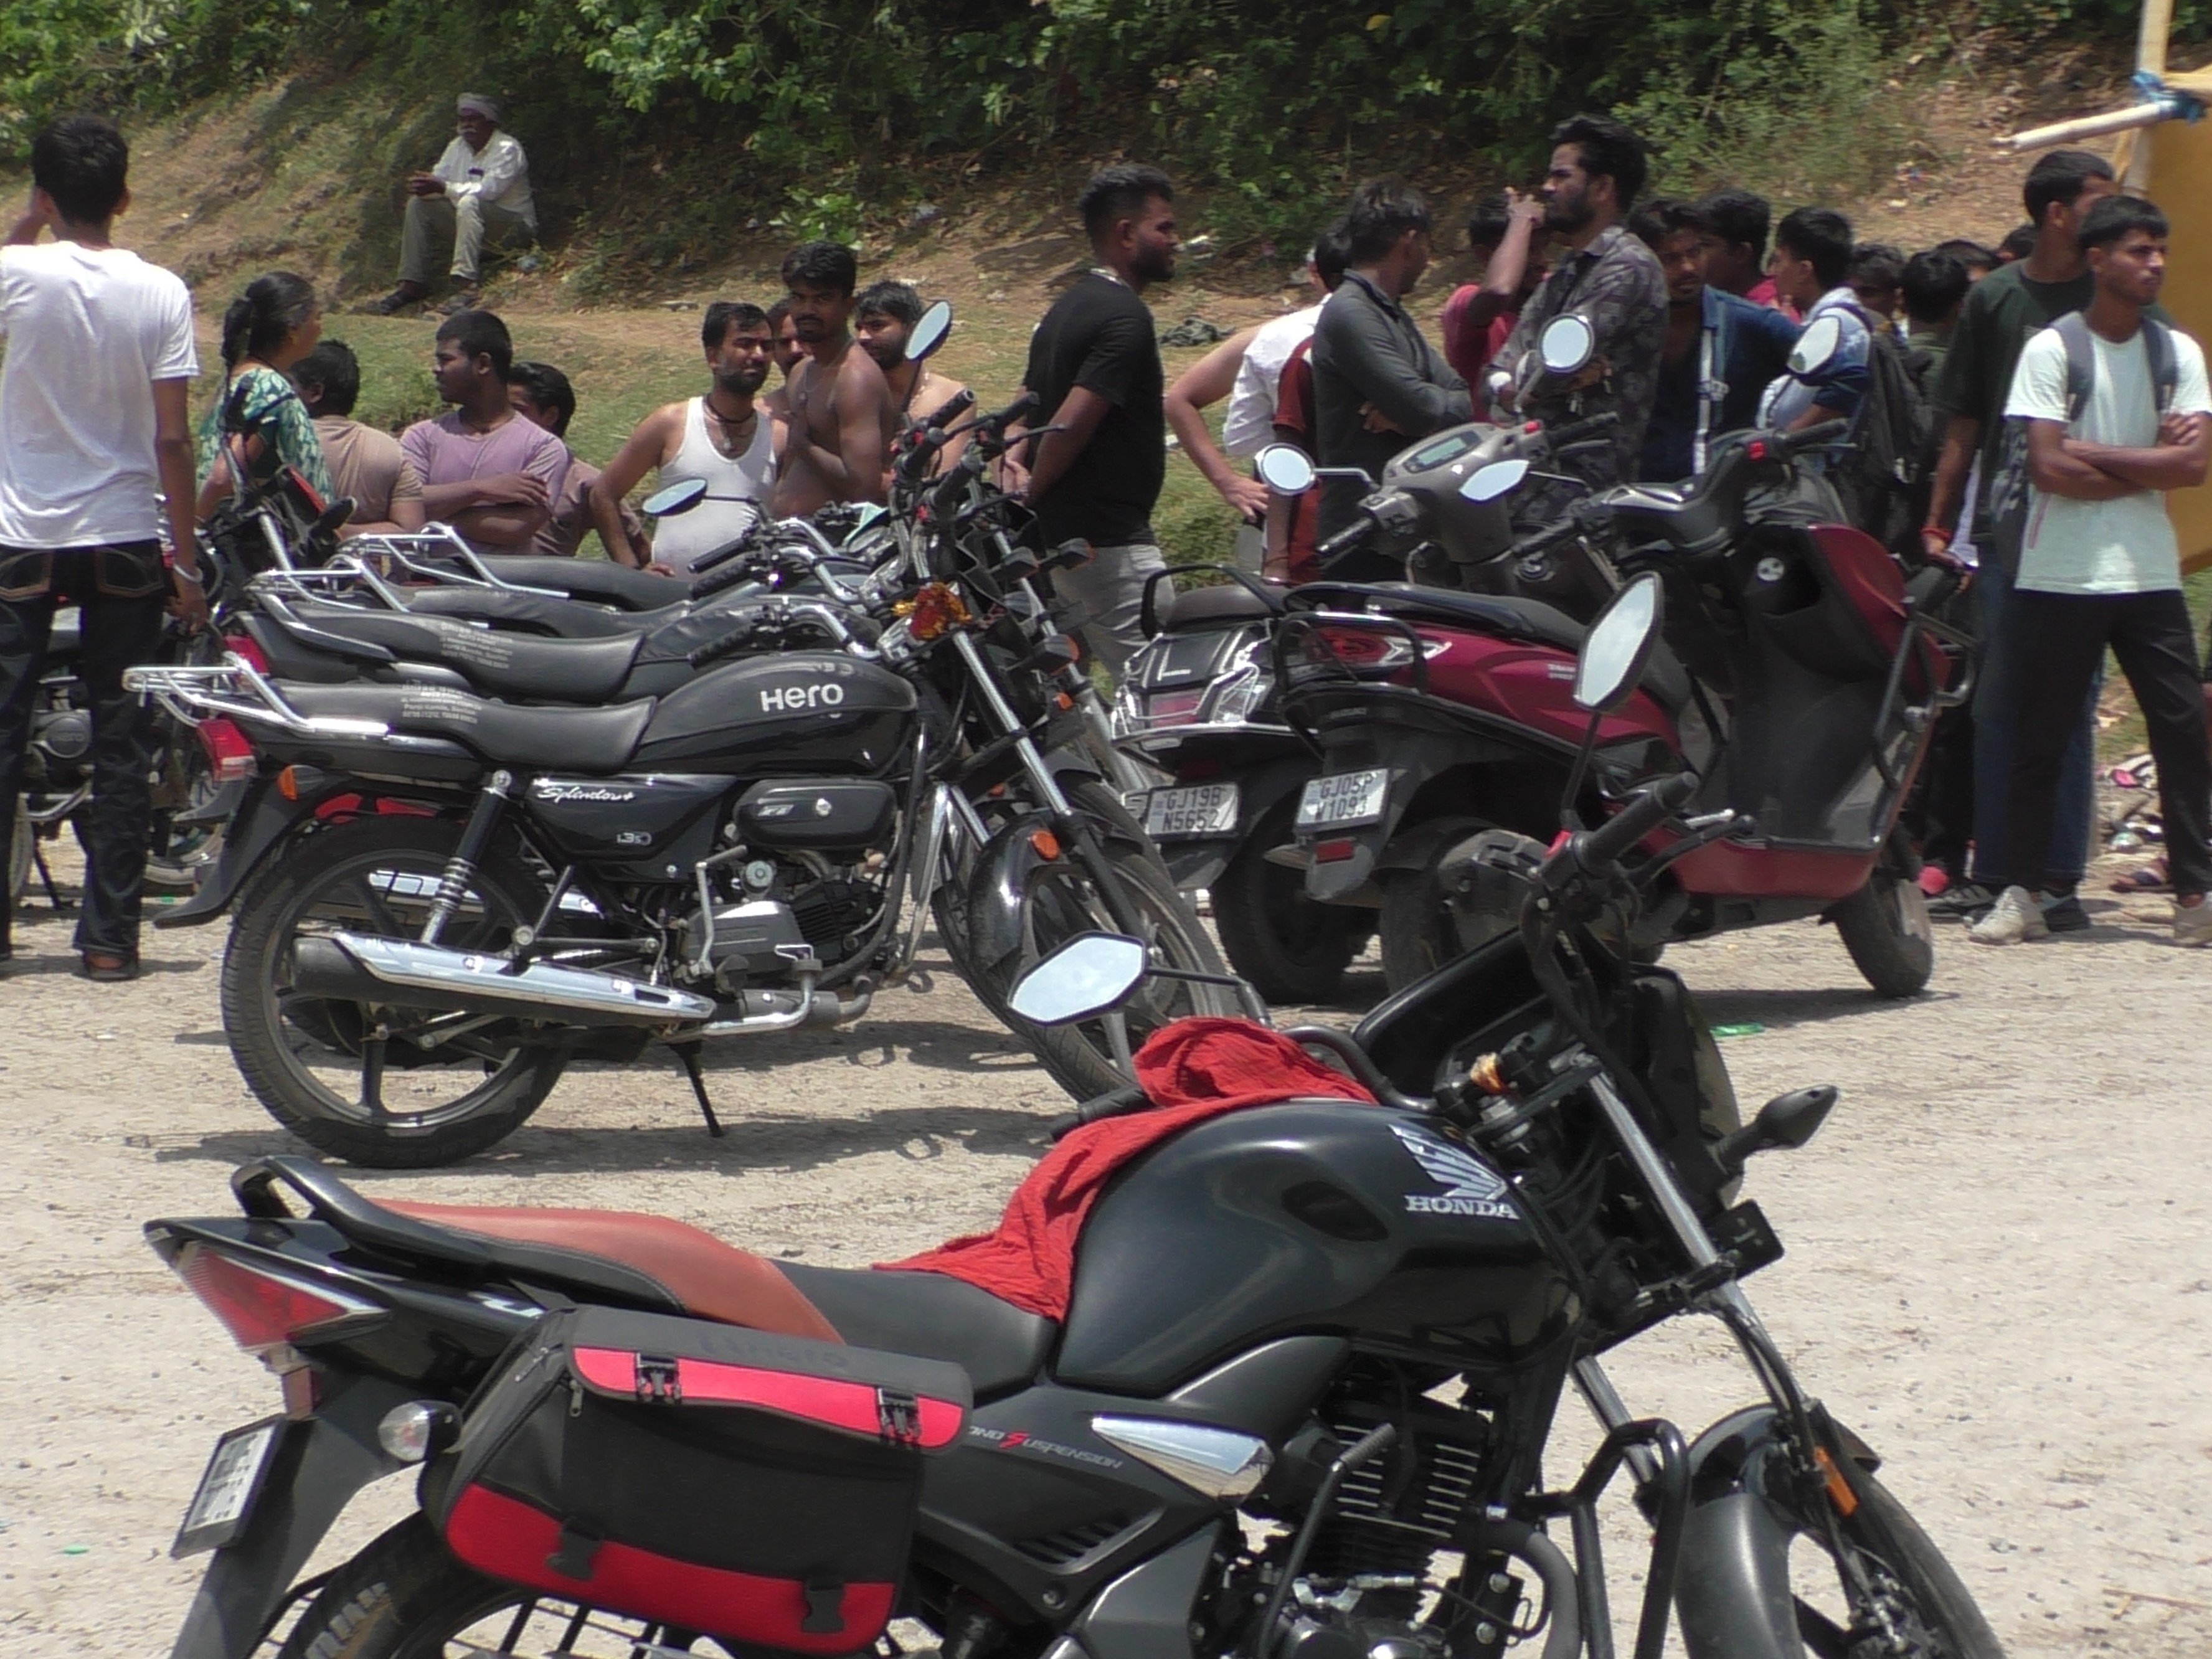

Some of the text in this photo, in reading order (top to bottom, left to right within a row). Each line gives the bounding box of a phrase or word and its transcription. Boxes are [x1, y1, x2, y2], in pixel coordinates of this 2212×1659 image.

[760, 683, 844, 712] Hero
[1166, 786, 1222, 811] GJ19B
[1404, 1194, 1521, 1221] HONDA
